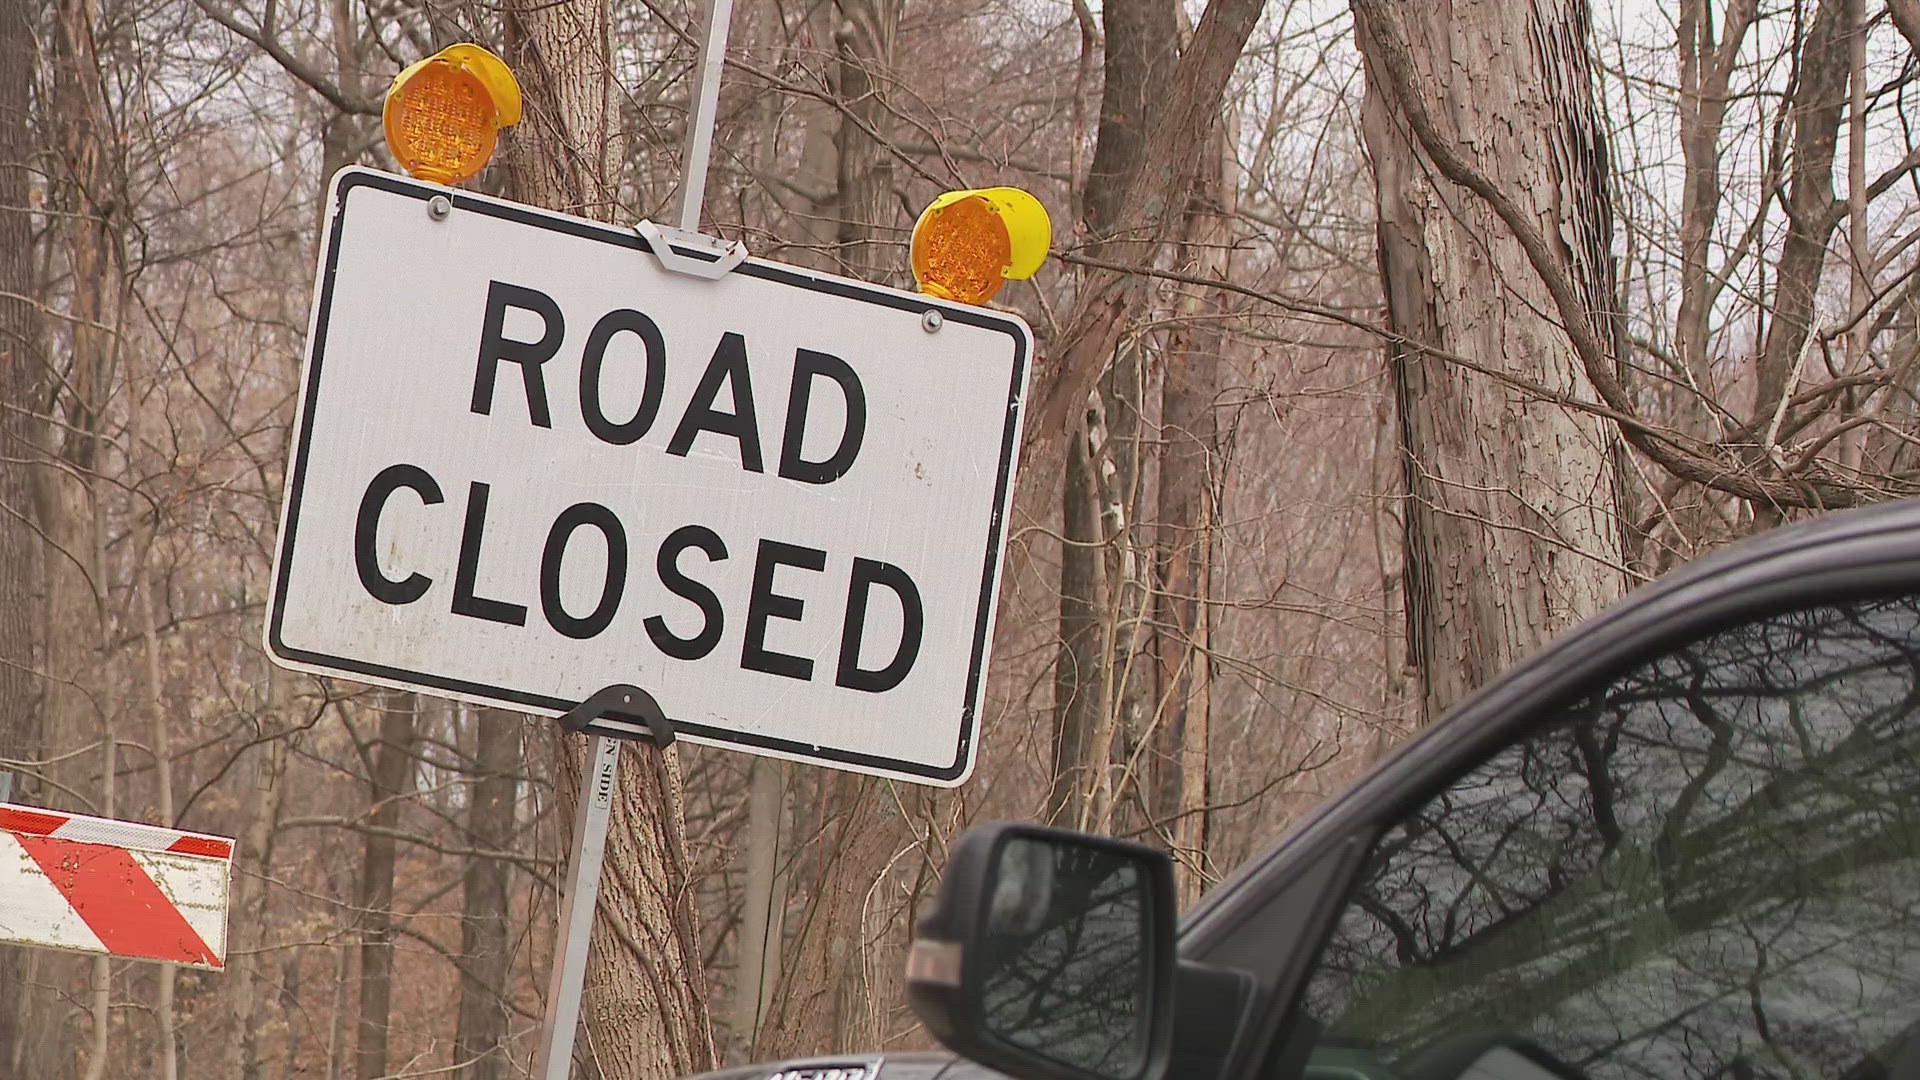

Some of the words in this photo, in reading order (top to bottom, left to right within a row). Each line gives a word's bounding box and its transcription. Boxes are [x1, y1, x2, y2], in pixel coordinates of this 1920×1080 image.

[469, 279, 867, 485] ROAD
[354, 463, 924, 694] CLOSED
[598, 763, 612, 802] SIDE
